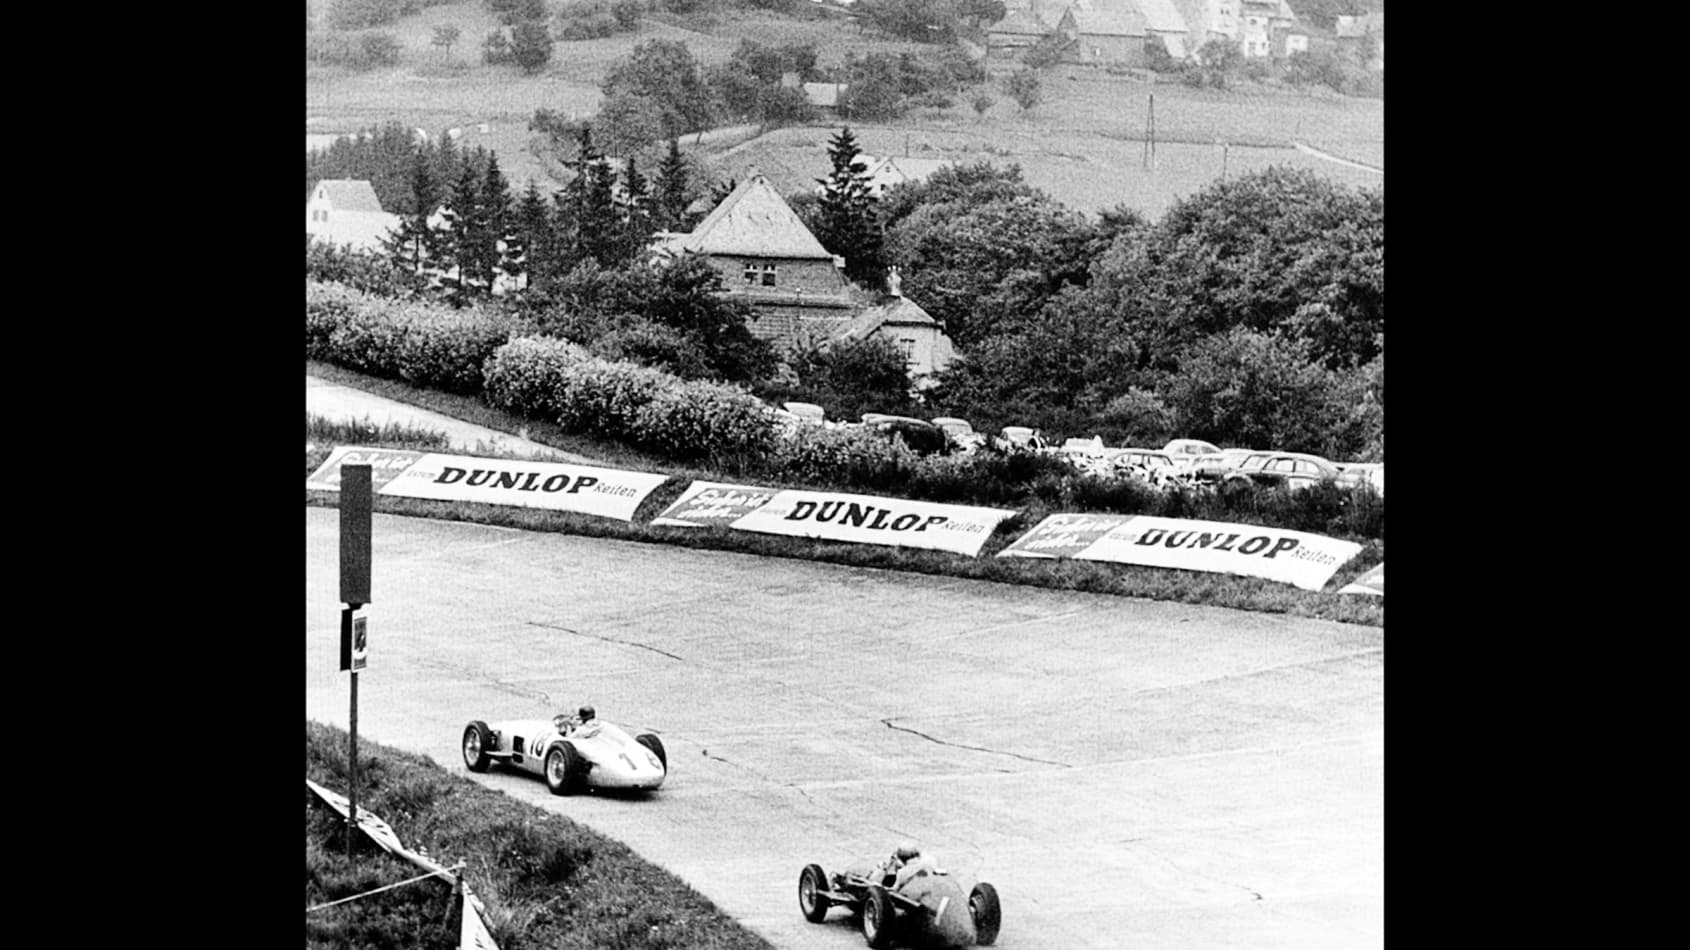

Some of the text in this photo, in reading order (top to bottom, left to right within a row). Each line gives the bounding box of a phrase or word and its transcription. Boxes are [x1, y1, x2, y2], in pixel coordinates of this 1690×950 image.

[433, 466, 599, 494] DUNLOP
[784, 500, 949, 532] DUNLOP
[1135, 528, 1300, 559] DUNLOP
